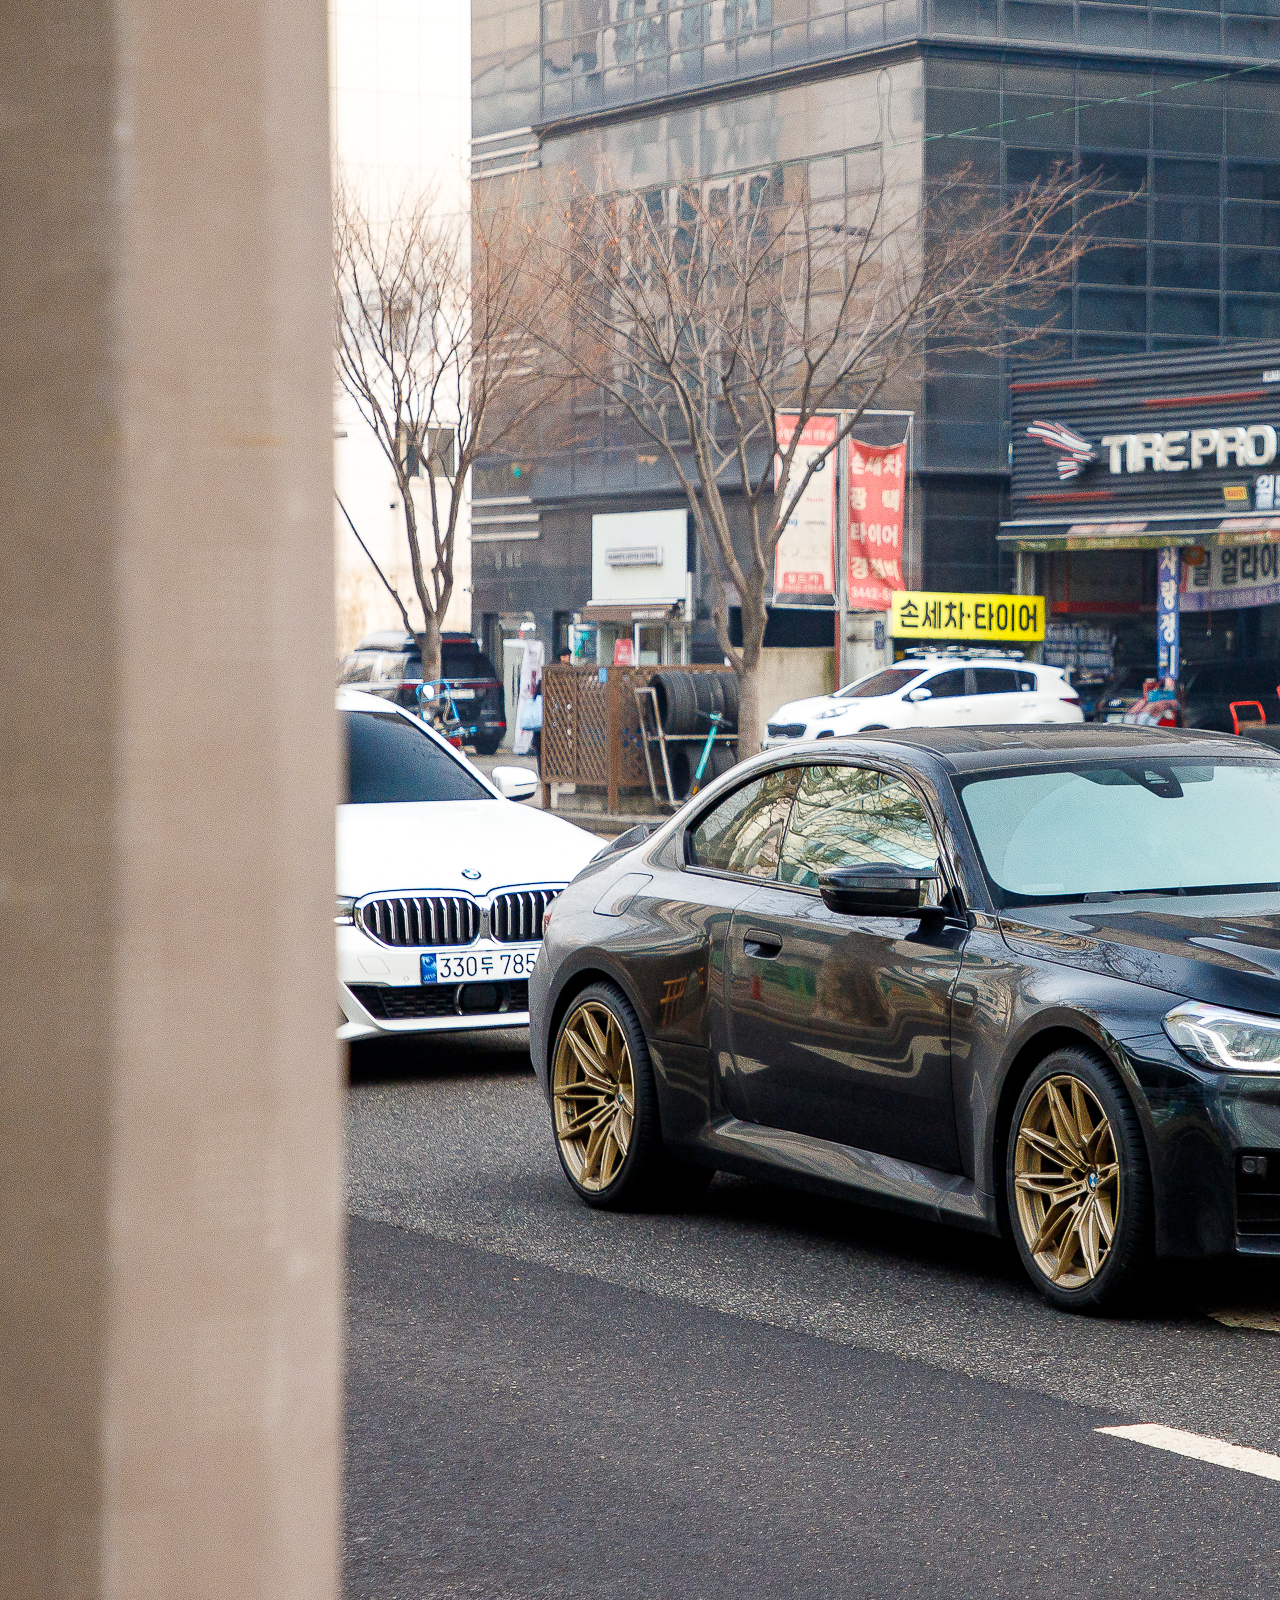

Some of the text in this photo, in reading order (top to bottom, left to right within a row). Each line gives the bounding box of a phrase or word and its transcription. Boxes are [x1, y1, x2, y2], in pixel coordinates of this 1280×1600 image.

[851, 453, 903, 477] 손세차
[850, 522, 899, 548] 타이어
[900, 599, 1038, 633] 손세차·타이어
[440, 957, 494, 978] 330두
